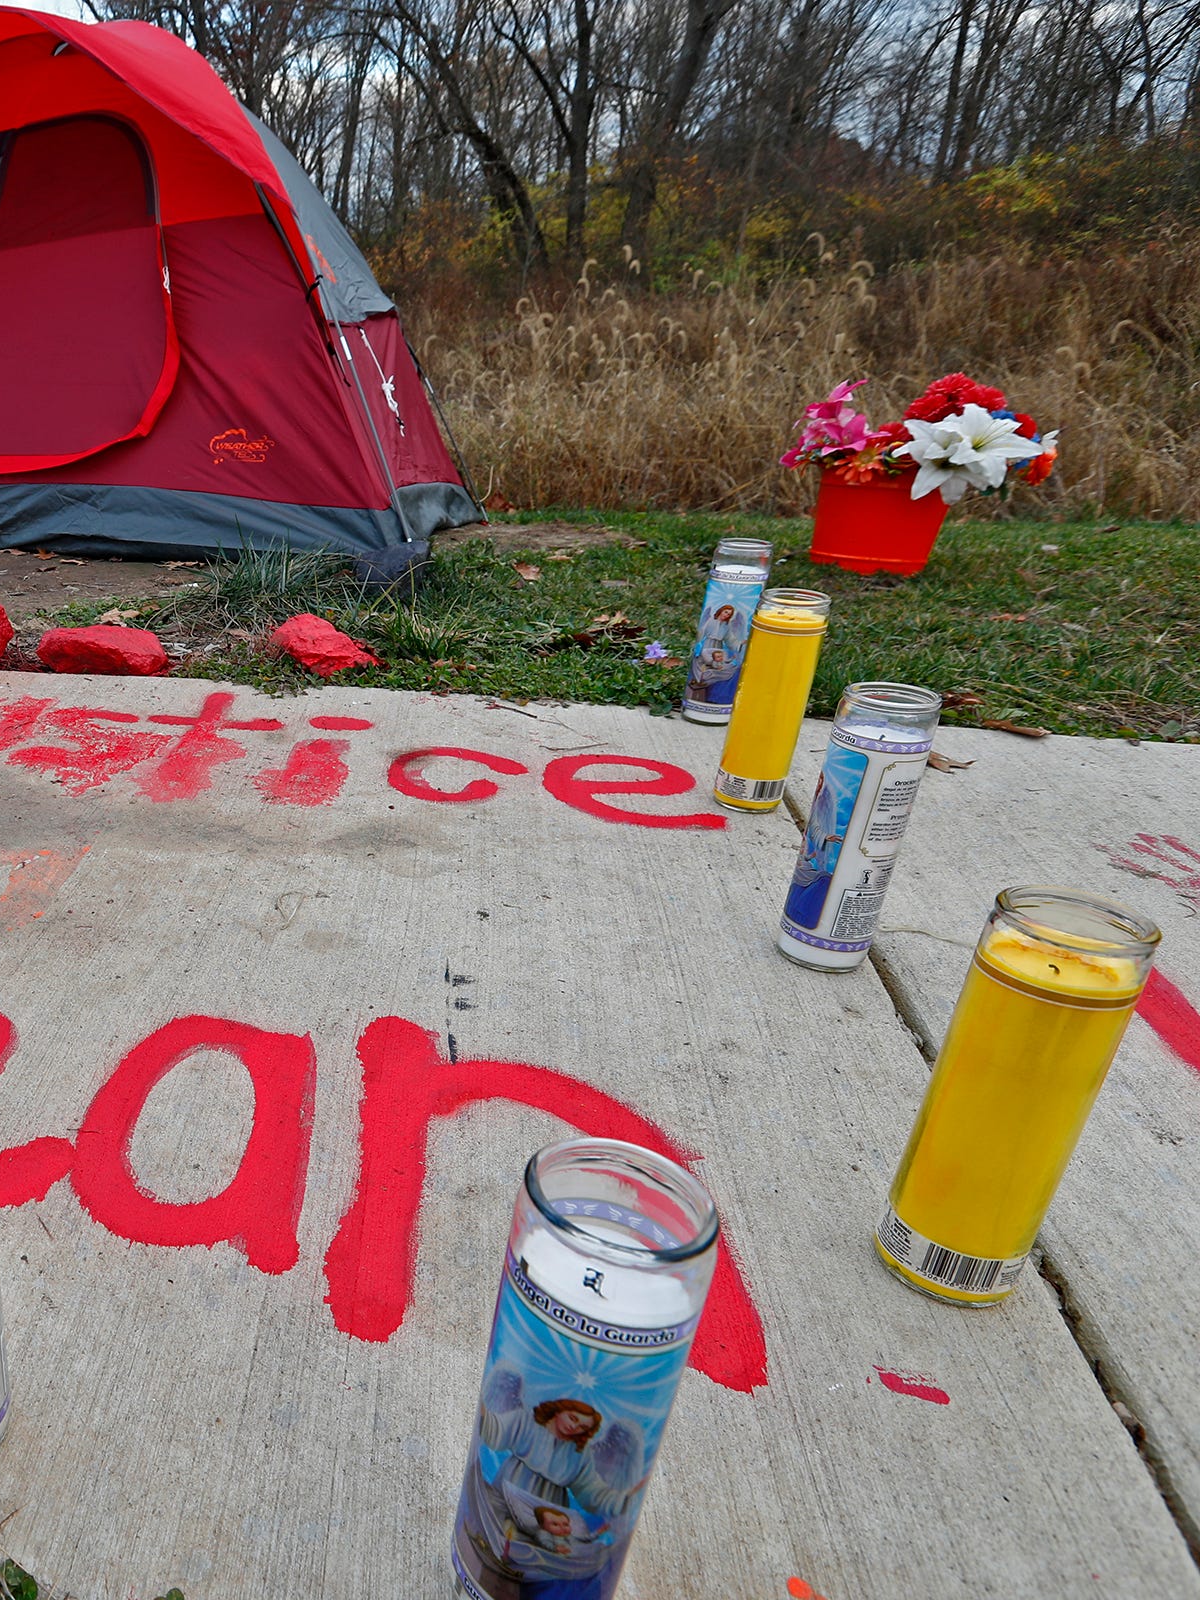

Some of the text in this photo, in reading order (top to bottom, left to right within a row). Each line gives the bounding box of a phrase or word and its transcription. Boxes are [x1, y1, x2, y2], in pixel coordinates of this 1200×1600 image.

[552, 1305, 576, 1326] de
[580, 1318, 599, 1336] la
[604, 1326, 675, 1344] Guarda
